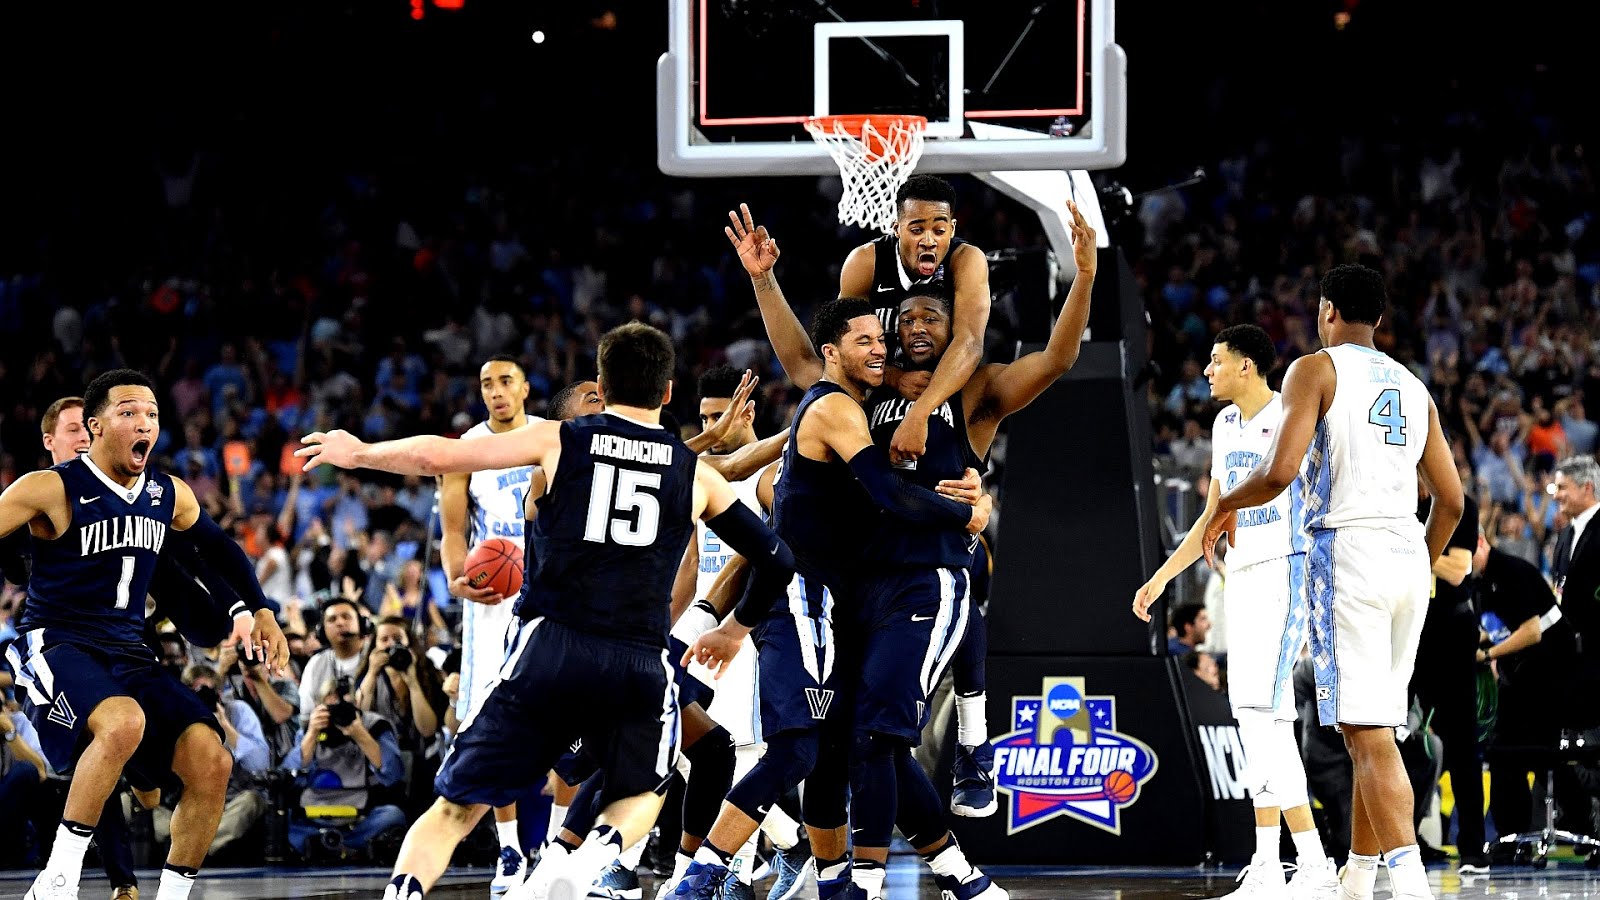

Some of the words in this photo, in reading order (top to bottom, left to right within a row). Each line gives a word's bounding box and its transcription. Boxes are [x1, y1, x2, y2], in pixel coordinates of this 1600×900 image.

[1369, 388, 1407, 446] 4
[590, 434, 673, 466] ARCIDIACONO
[583, 462, 661, 547] 15
[114, 556, 136, 610] 1
[1049, 698, 1080, 711] NCAA
[993, 746, 1064, 776] FINAL
[1066, 746, 1137, 776] FOUR
[1017, 777, 1070, 786] HOUSTON
[1072, 777, 1102, 786] 2016
[1198, 724, 1252, 800] NCA
